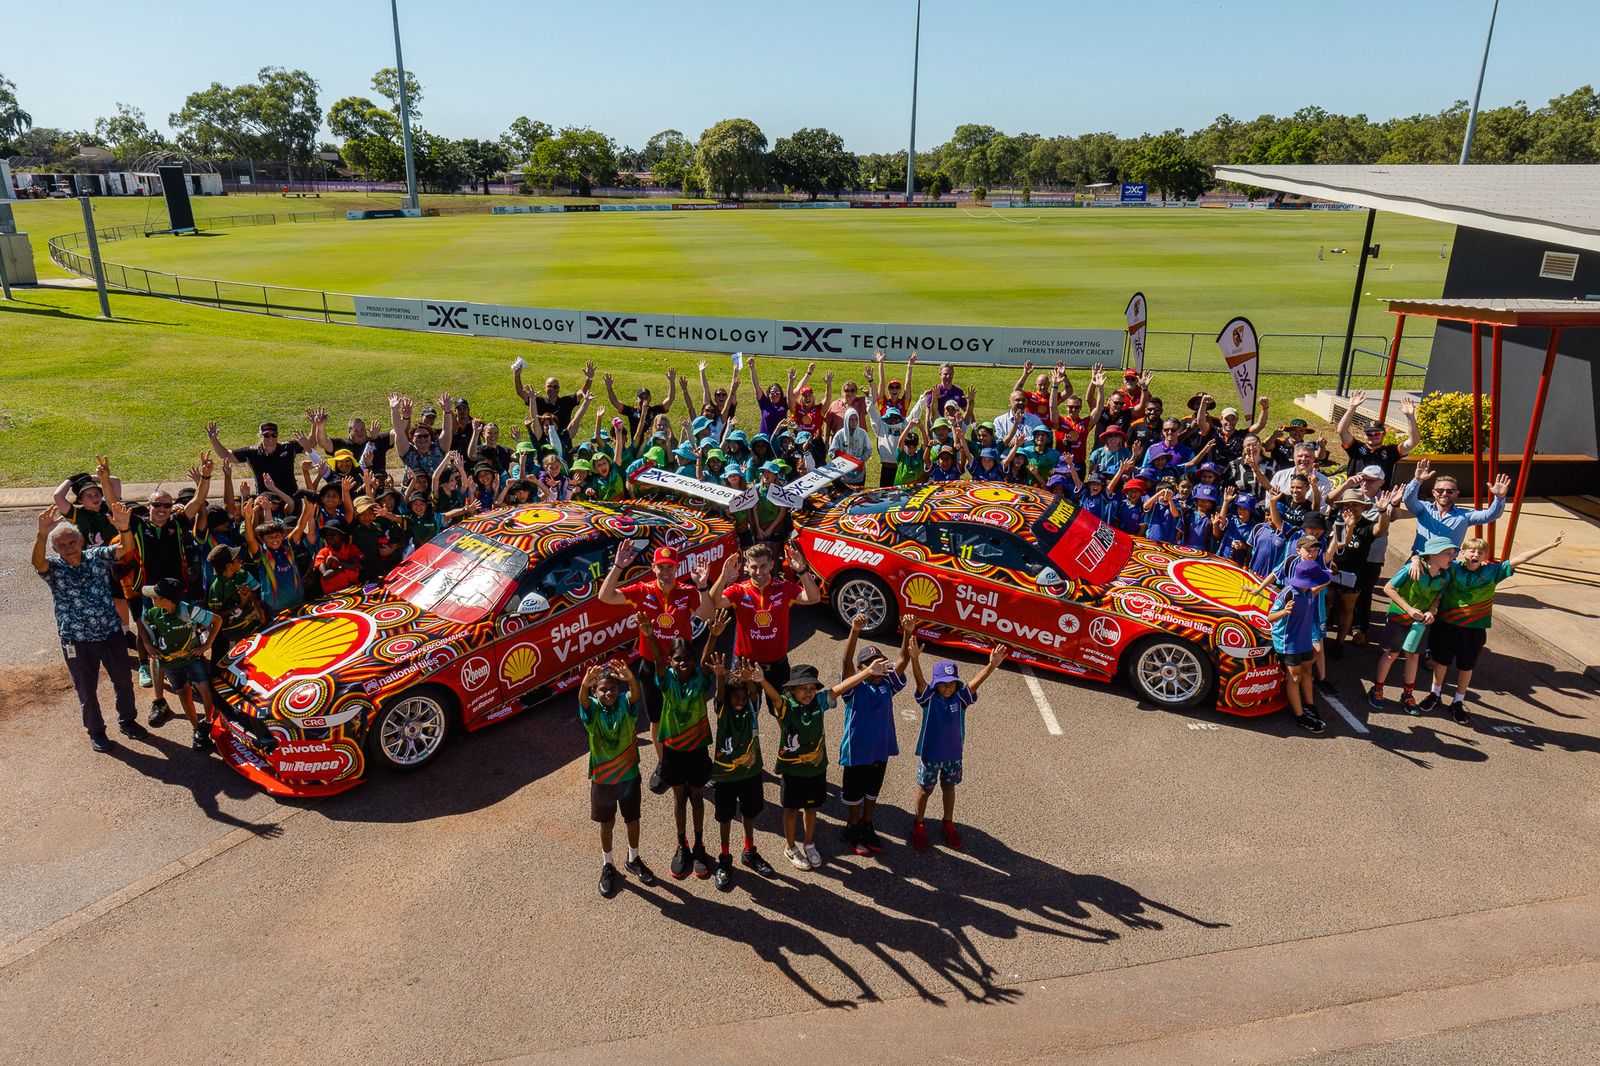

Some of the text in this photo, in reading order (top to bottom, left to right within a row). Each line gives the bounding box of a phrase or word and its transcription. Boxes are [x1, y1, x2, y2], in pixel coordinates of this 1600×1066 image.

[381, 312, 403, 320] TERRITORY
[427, 305, 575, 333] DXC TECHNOLOGY
[586, 315, 769, 344] DXC TECHNOLOGY
[782, 326, 995, 353] DXC TECHNOLOGY
[1237, 364, 1253, 397] DXC
[642, 469, 677, 483] DXC
[734, 489, 754, 507] DXC
[772, 485, 795, 503] DXC
[972, 515, 999, 525] Pasquale
[1048, 499, 1076, 529] PIRTEK
[566, 534, 589, 546] Davison
[667, 535, 688, 546] MAN
[829, 538, 884, 567] Repco
[960, 544, 973, 560] 11
[588, 561, 601, 579] 17
[956, 584, 998, 608] Shell
[551, 611, 589, 643] Shell
[955, 600, 1067, 649] V-Power
[1092, 617, 1119, 641] Rheem
[1154, 613, 1214, 635] national tiles
[394, 629, 469, 664] FORDPERFORMANCE
[552, 613, 640, 663] V-Powe
[1084, 648, 1115, 661] DUNLOP
[379, 656, 439, 687] national tiles
[463, 661, 489, 688] Rheem
[1246, 679, 1277, 695] Repco
[303, 718, 326, 727] CRC
[1186, 723, 1219, 731] NTC
[1491, 725, 1526, 734] NTC
[293, 760, 340, 773] Repco
